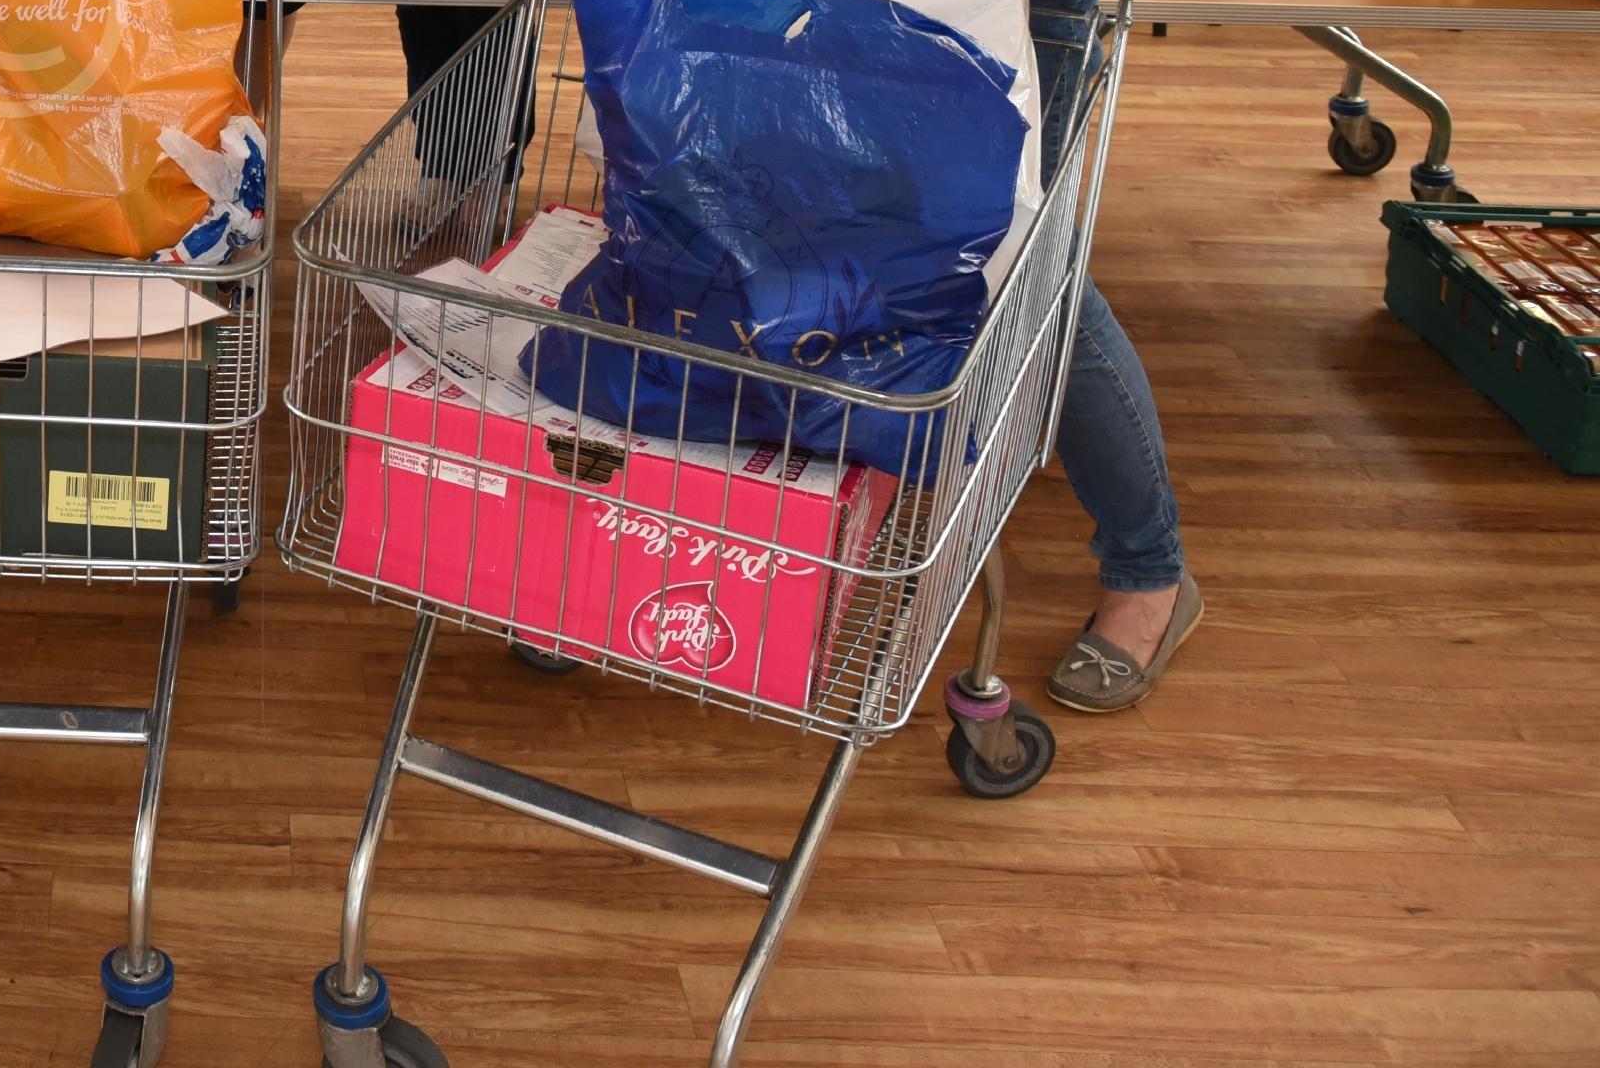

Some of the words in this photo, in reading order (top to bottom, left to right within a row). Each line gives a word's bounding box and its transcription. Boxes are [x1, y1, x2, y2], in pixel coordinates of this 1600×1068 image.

[586, 498, 690, 560] Lady
[688, 536, 817, 583] Pink
[644, 602, 712, 631] Lady
[652, 624, 721, 653] Pink
